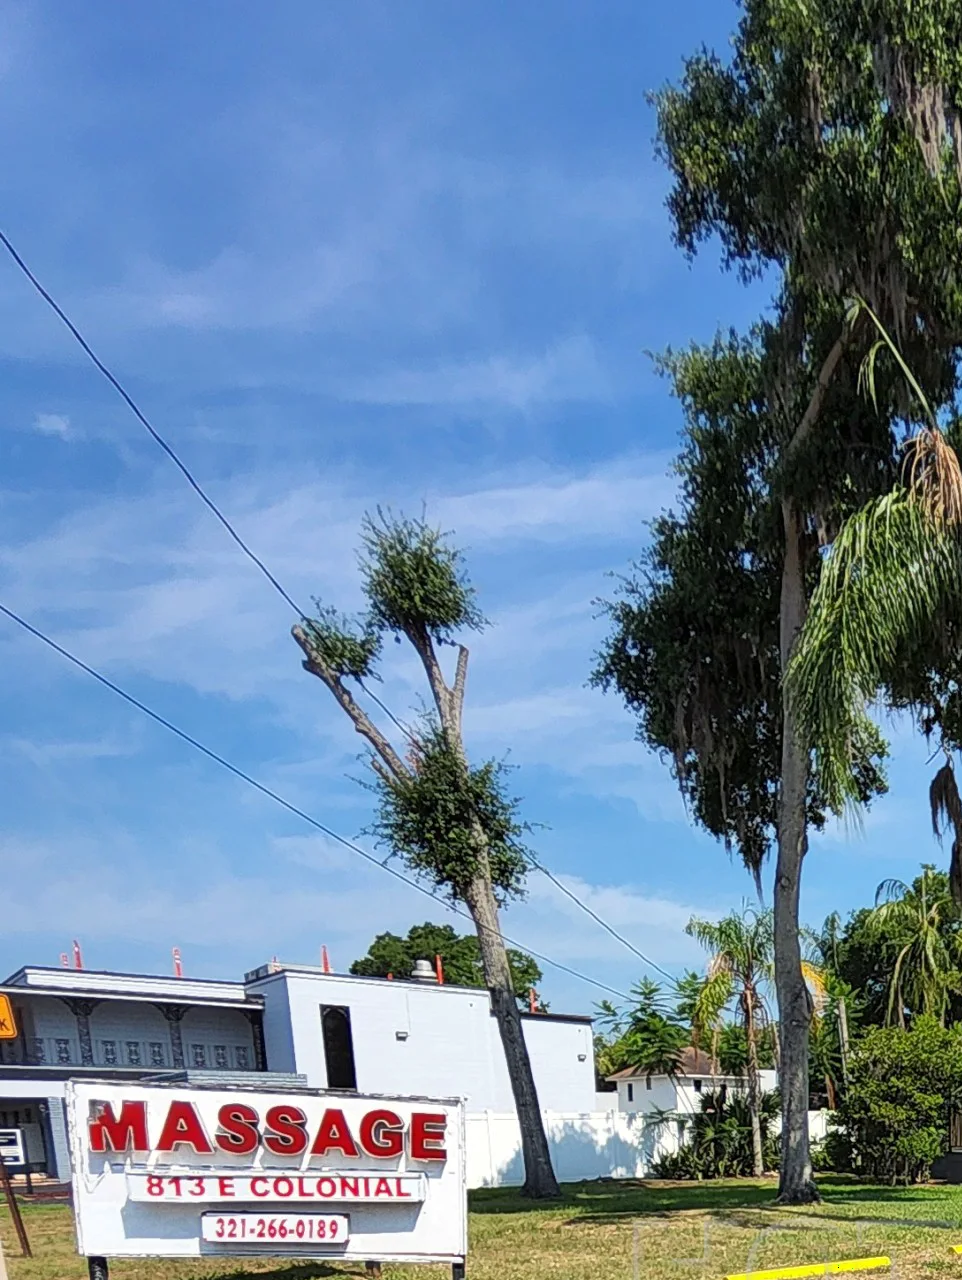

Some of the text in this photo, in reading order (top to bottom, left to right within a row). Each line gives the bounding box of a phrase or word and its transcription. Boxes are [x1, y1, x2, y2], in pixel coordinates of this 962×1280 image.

[88, 1099, 448, 1161] MASSAGE
[146, 1175, 411, 1198] 813 E COLONIAL
[215, 1217, 339, 1239] 321-266-0189
